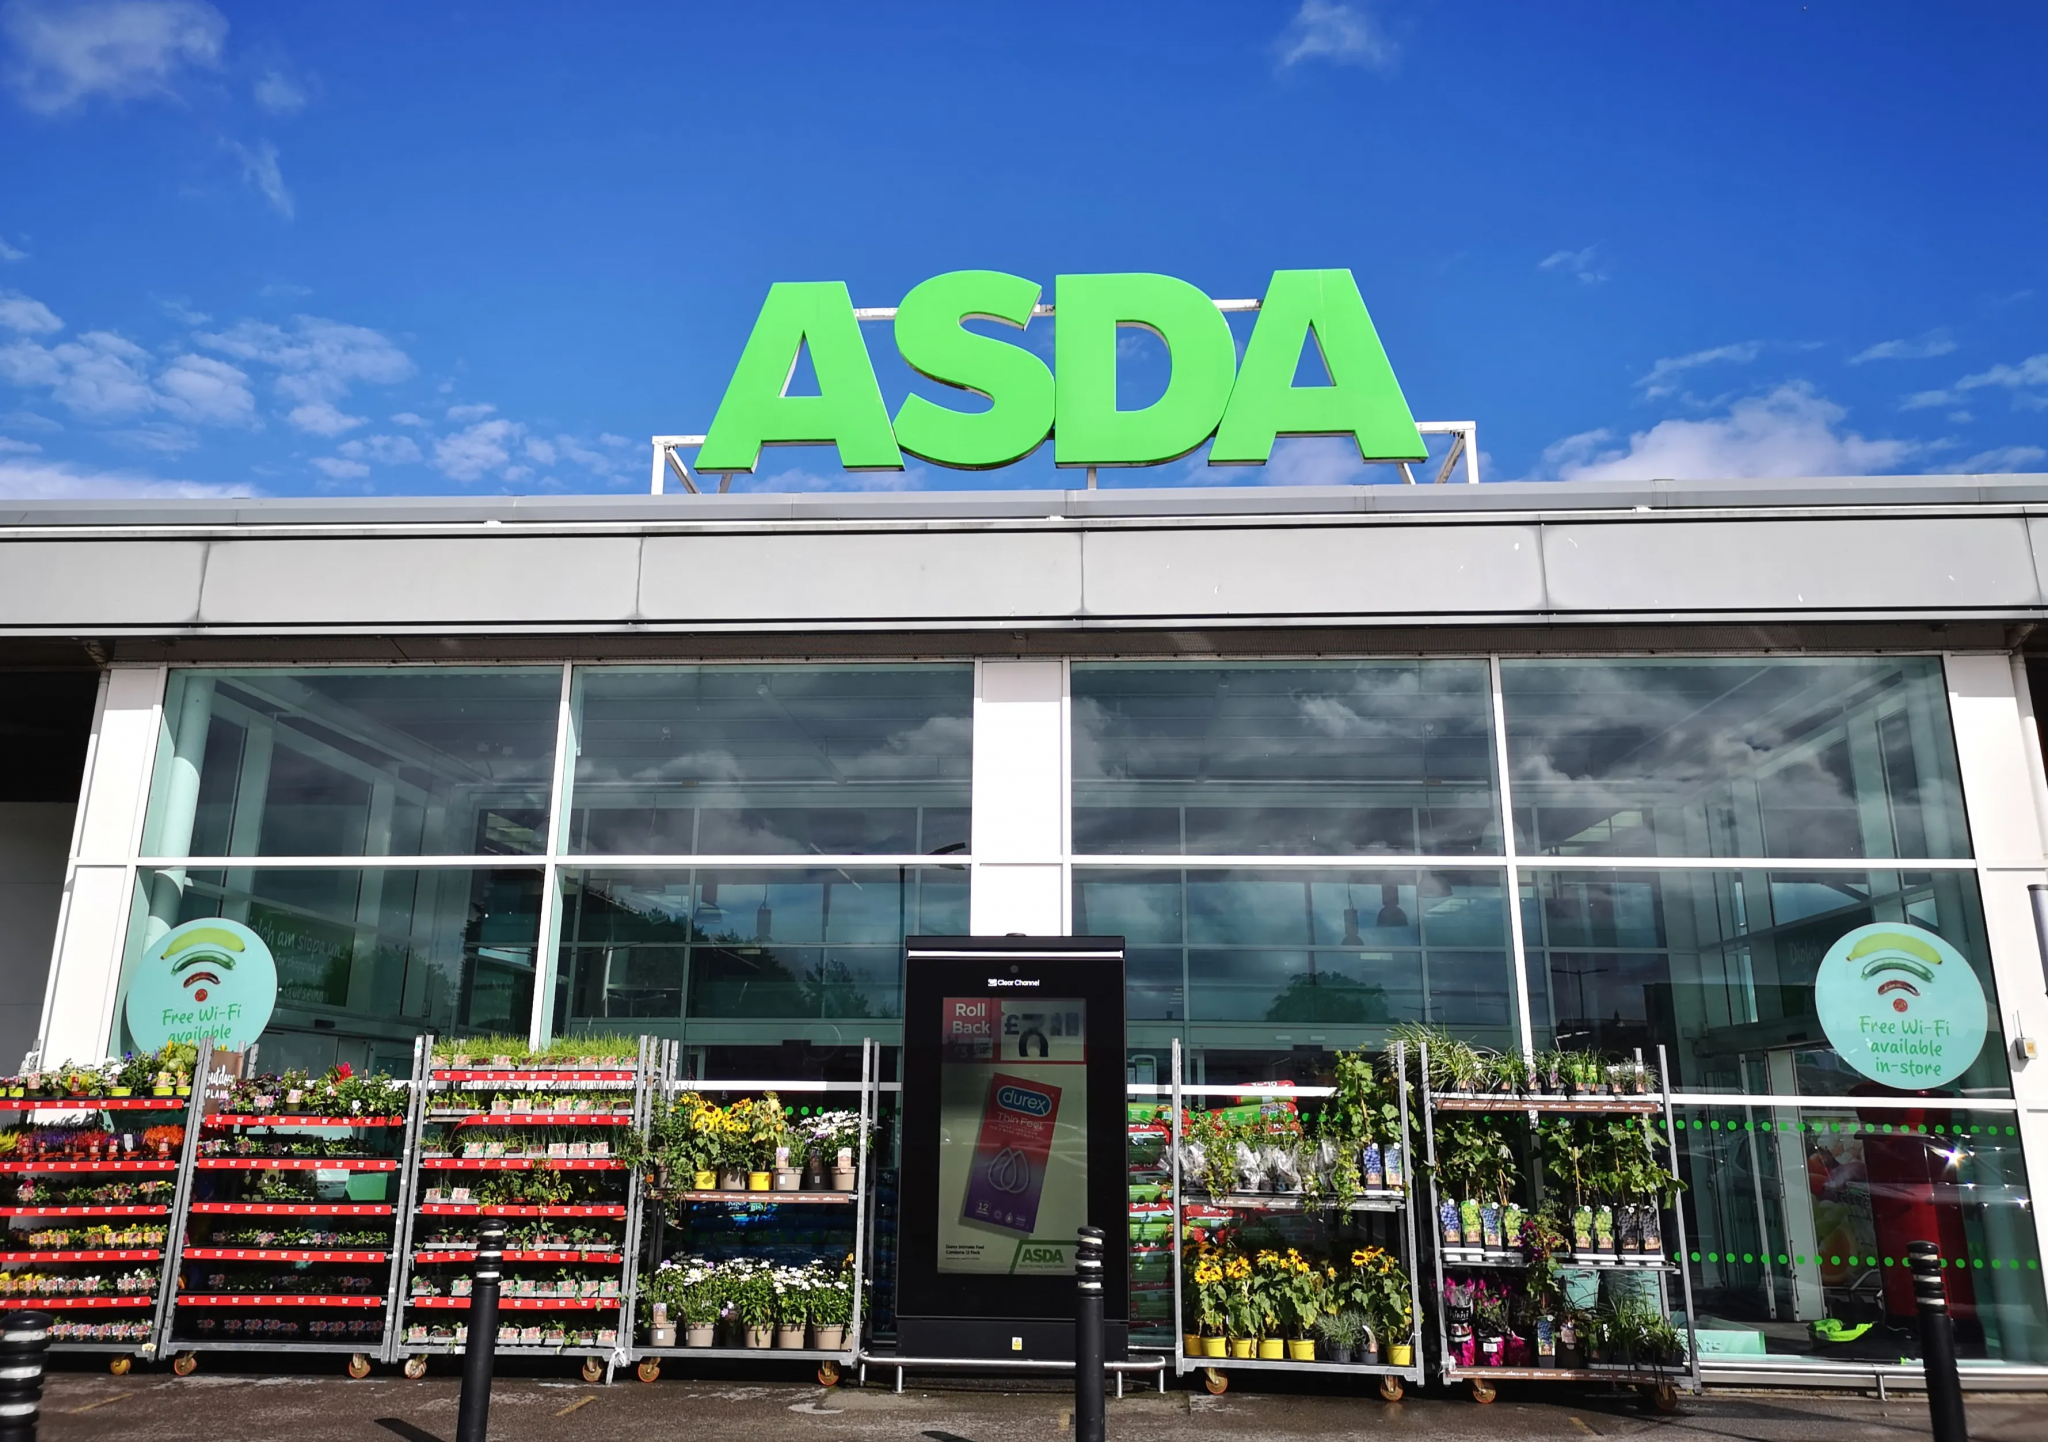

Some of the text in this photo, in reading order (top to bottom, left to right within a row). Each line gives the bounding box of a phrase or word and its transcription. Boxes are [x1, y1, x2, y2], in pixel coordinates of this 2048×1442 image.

[693, 269, 1429, 473] ASDA
[162, 1003, 242, 1026] Free Wi-Fi
[955, 1003, 986, 1017] Roll
[168, 1023, 232, 1043] available
[952, 1020, 991, 1034] Back
[1859, 1016, 1950, 1037] Free Wi-Fi
[1870, 1038, 1943, 1057] available
[1876, 1057, 1942, 1078] in-store
[1002, 1090, 1047, 1115] durex
[997, 1112, 1045, 1131] Thin Feel
[977, 1202, 989, 1212] 12
[1021, 1248, 1064, 1263] ASDA
